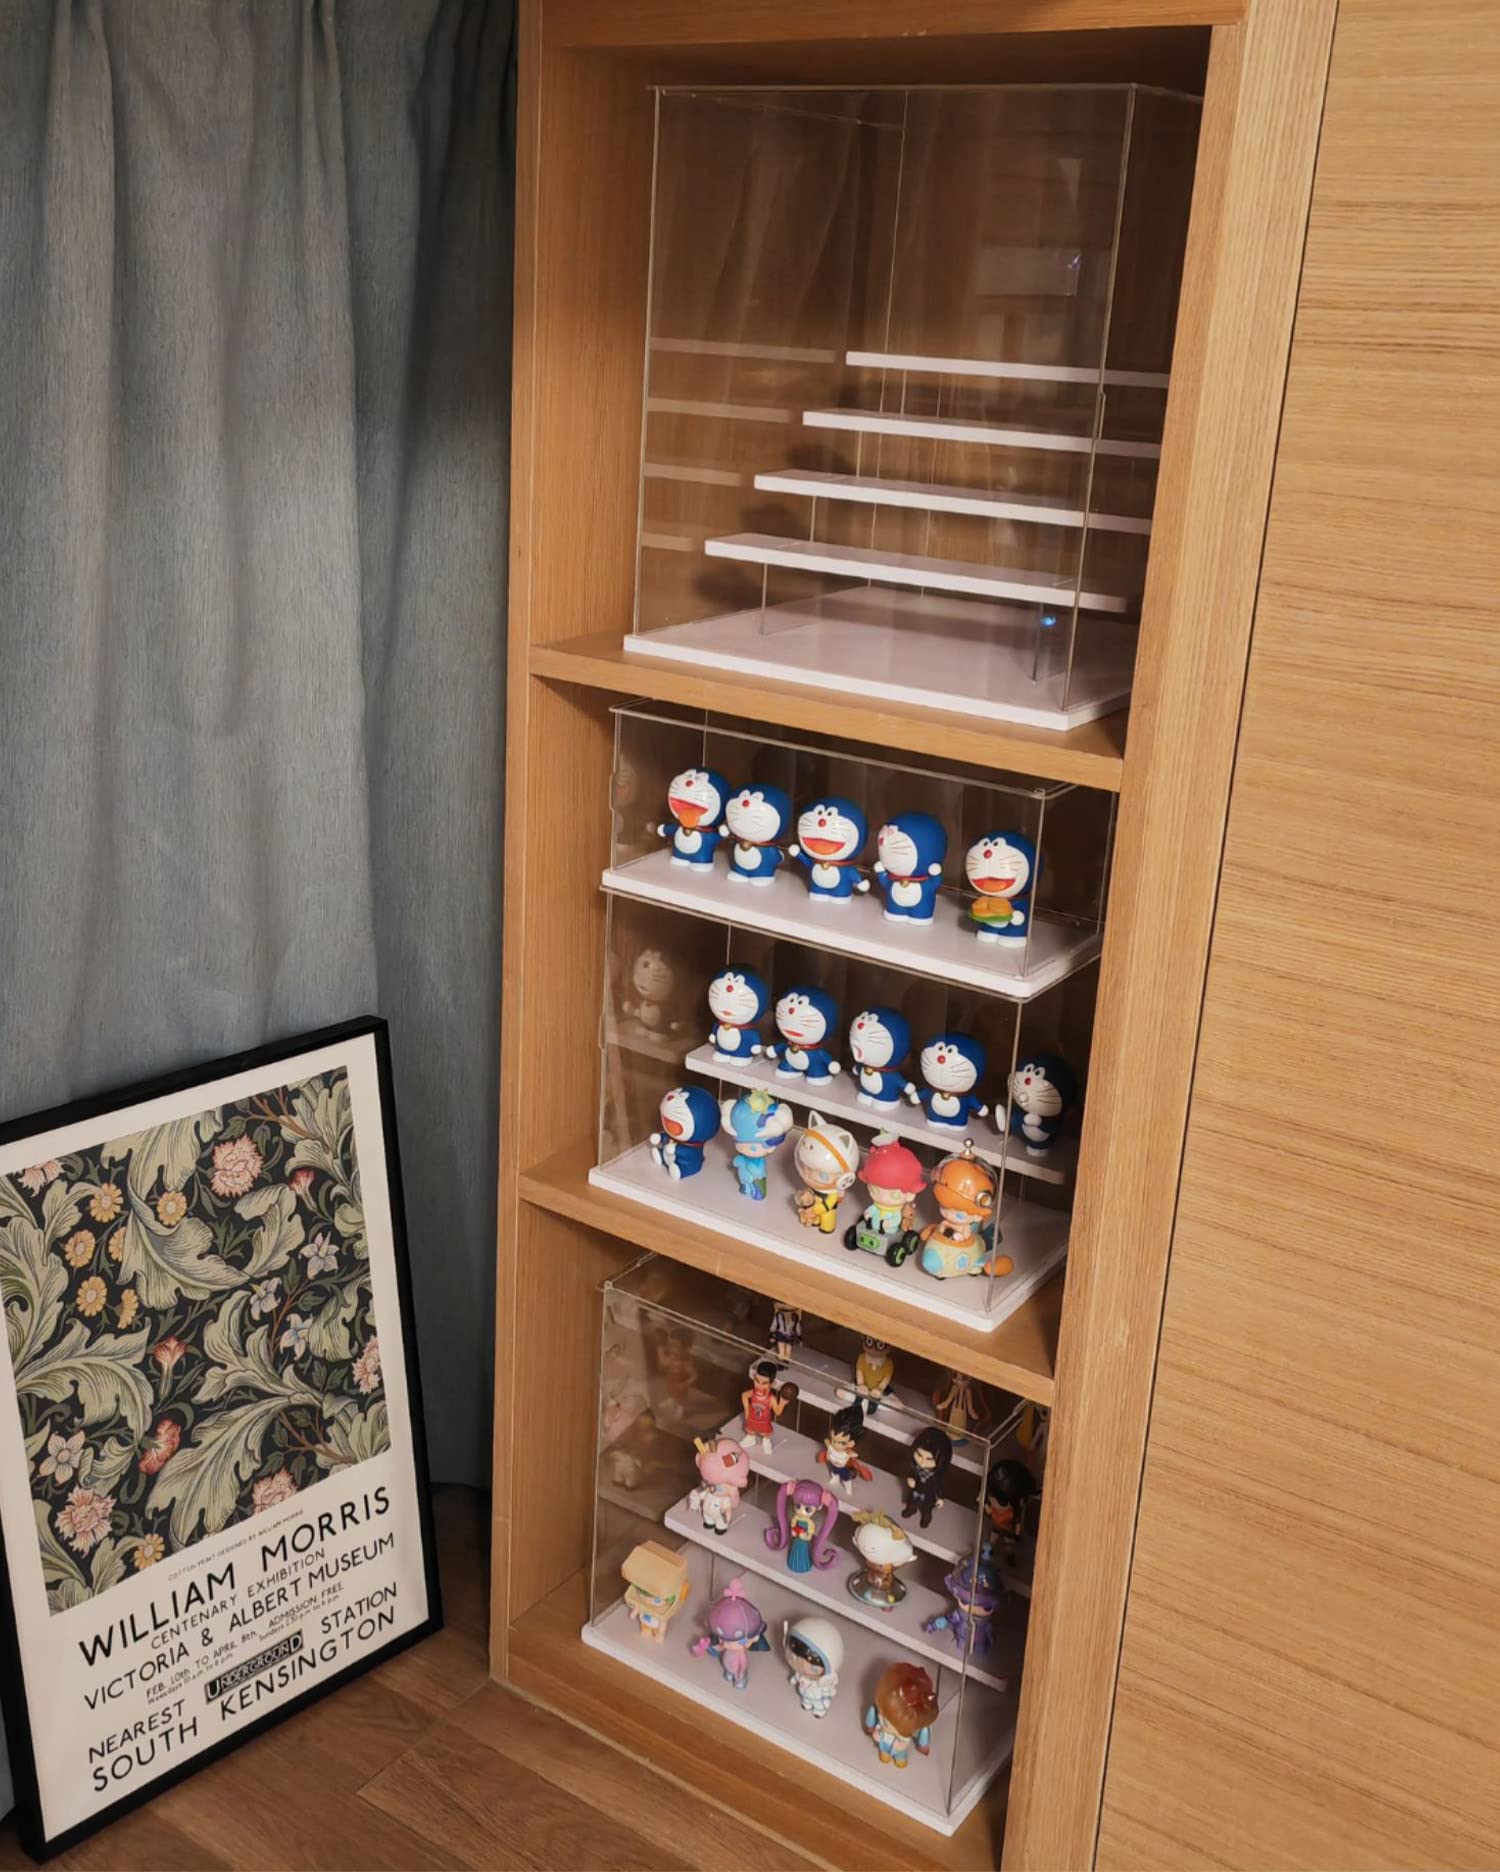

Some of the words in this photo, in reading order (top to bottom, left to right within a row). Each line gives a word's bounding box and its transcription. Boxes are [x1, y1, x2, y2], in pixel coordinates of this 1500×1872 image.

[79, 1561, 236, 1667] WILLIAM
[261, 1486, 390, 1573] MORRIS
[84, 1641, 189, 1710] VICTORIA
[201, 1627, 213, 1647] &
[229, 1577, 302, 1633] ALBERT
[308, 1531, 395, 1589] MUSEUM
[151, 1594, 237, 1650] CENTENARY
[247, 1548, 326, 1599] EXHIBITION
[195, 1655, 209, 1669] TO
[268, 1595, 317, 1628] ADMISSION
[321, 1581, 344, 1599] FREE
[88, 1698, 185, 1764] NEAREST
[206, 1633, 302, 1699] UNDERGROUND
[321, 1581, 397, 1635] STATION
[92, 1716, 198, 1792] SOUTH
[220, 1605, 395, 1721] KENSINGTON
